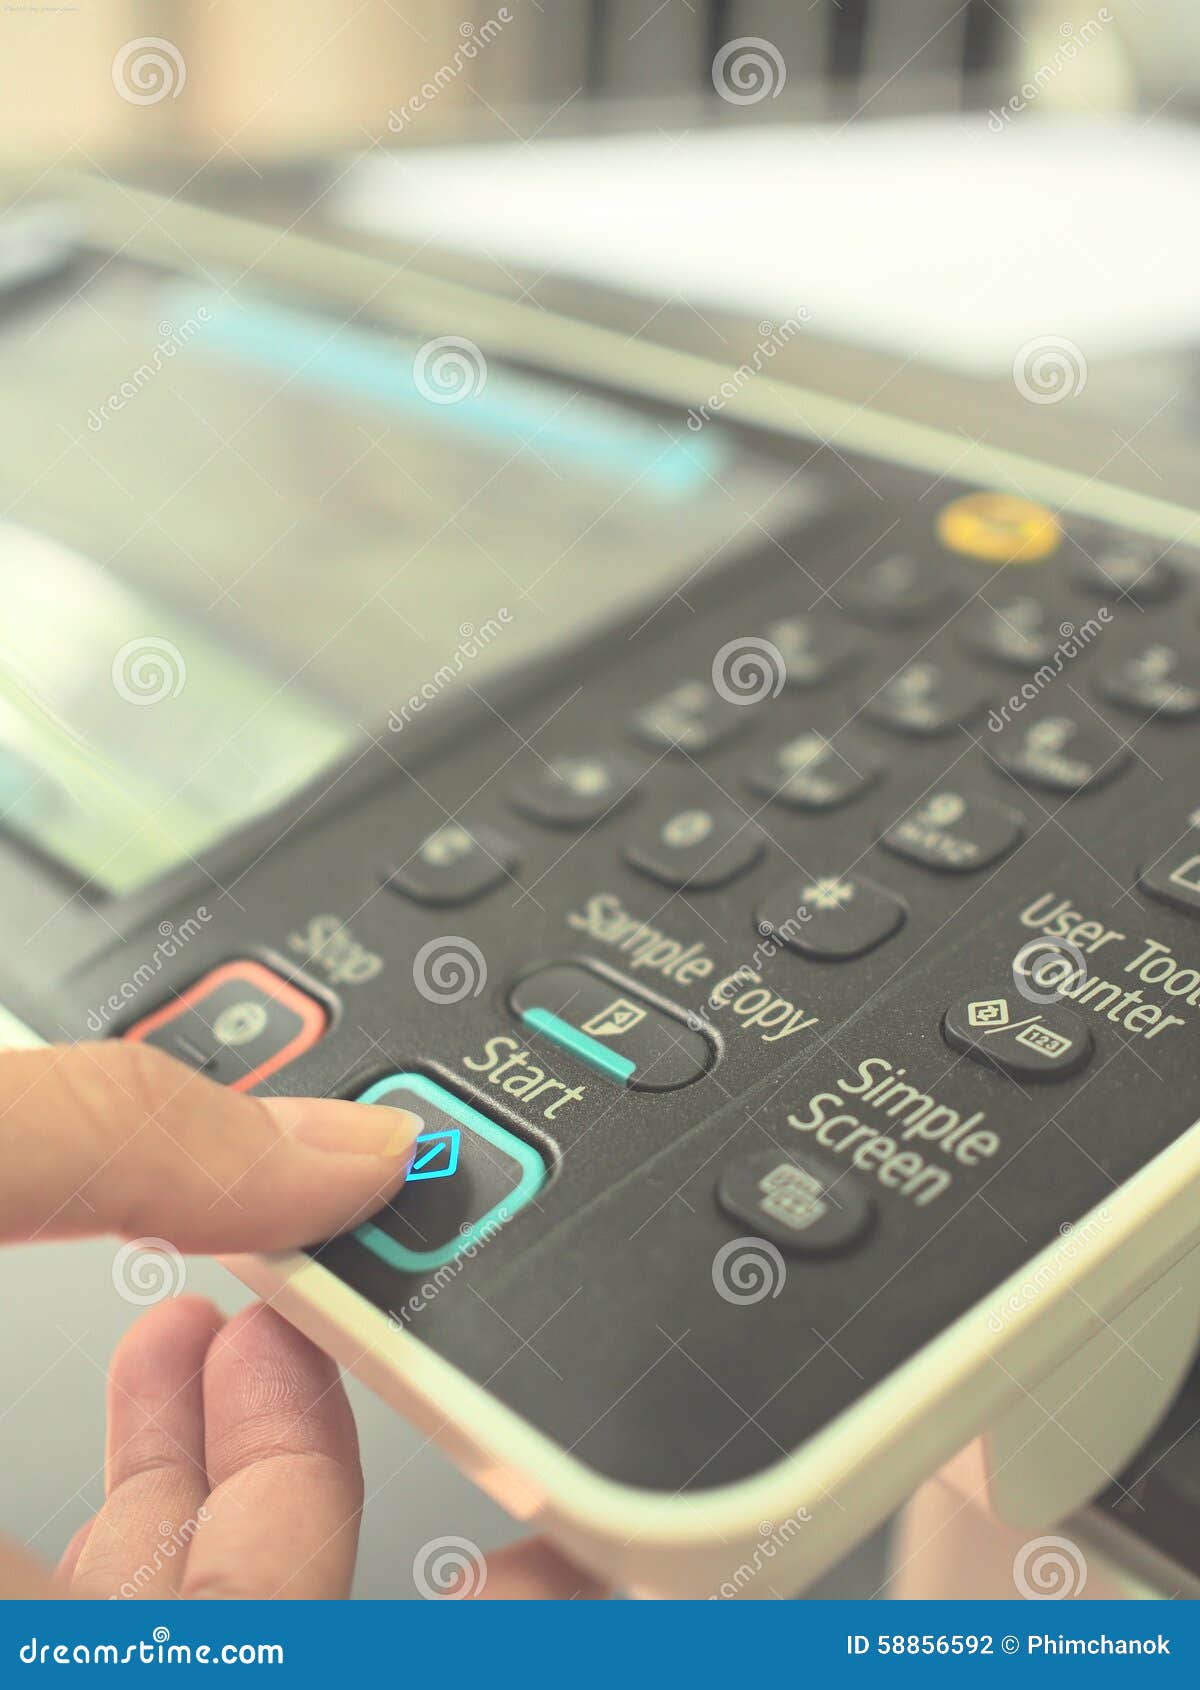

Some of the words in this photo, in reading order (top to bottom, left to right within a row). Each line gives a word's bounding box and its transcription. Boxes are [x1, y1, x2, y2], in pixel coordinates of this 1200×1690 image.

[288, 914, 383, 985] Stop
[566, 892, 714, 985] Sample
[711, 969, 818, 1041] Copy
[1020, 892, 1126, 953] User
[1012, 942, 1185, 1039] Counter
[463, 1036, 586, 1120] Start
[837, 1057, 1000, 1166] Simple
[787, 1092, 952, 1207] Screen
